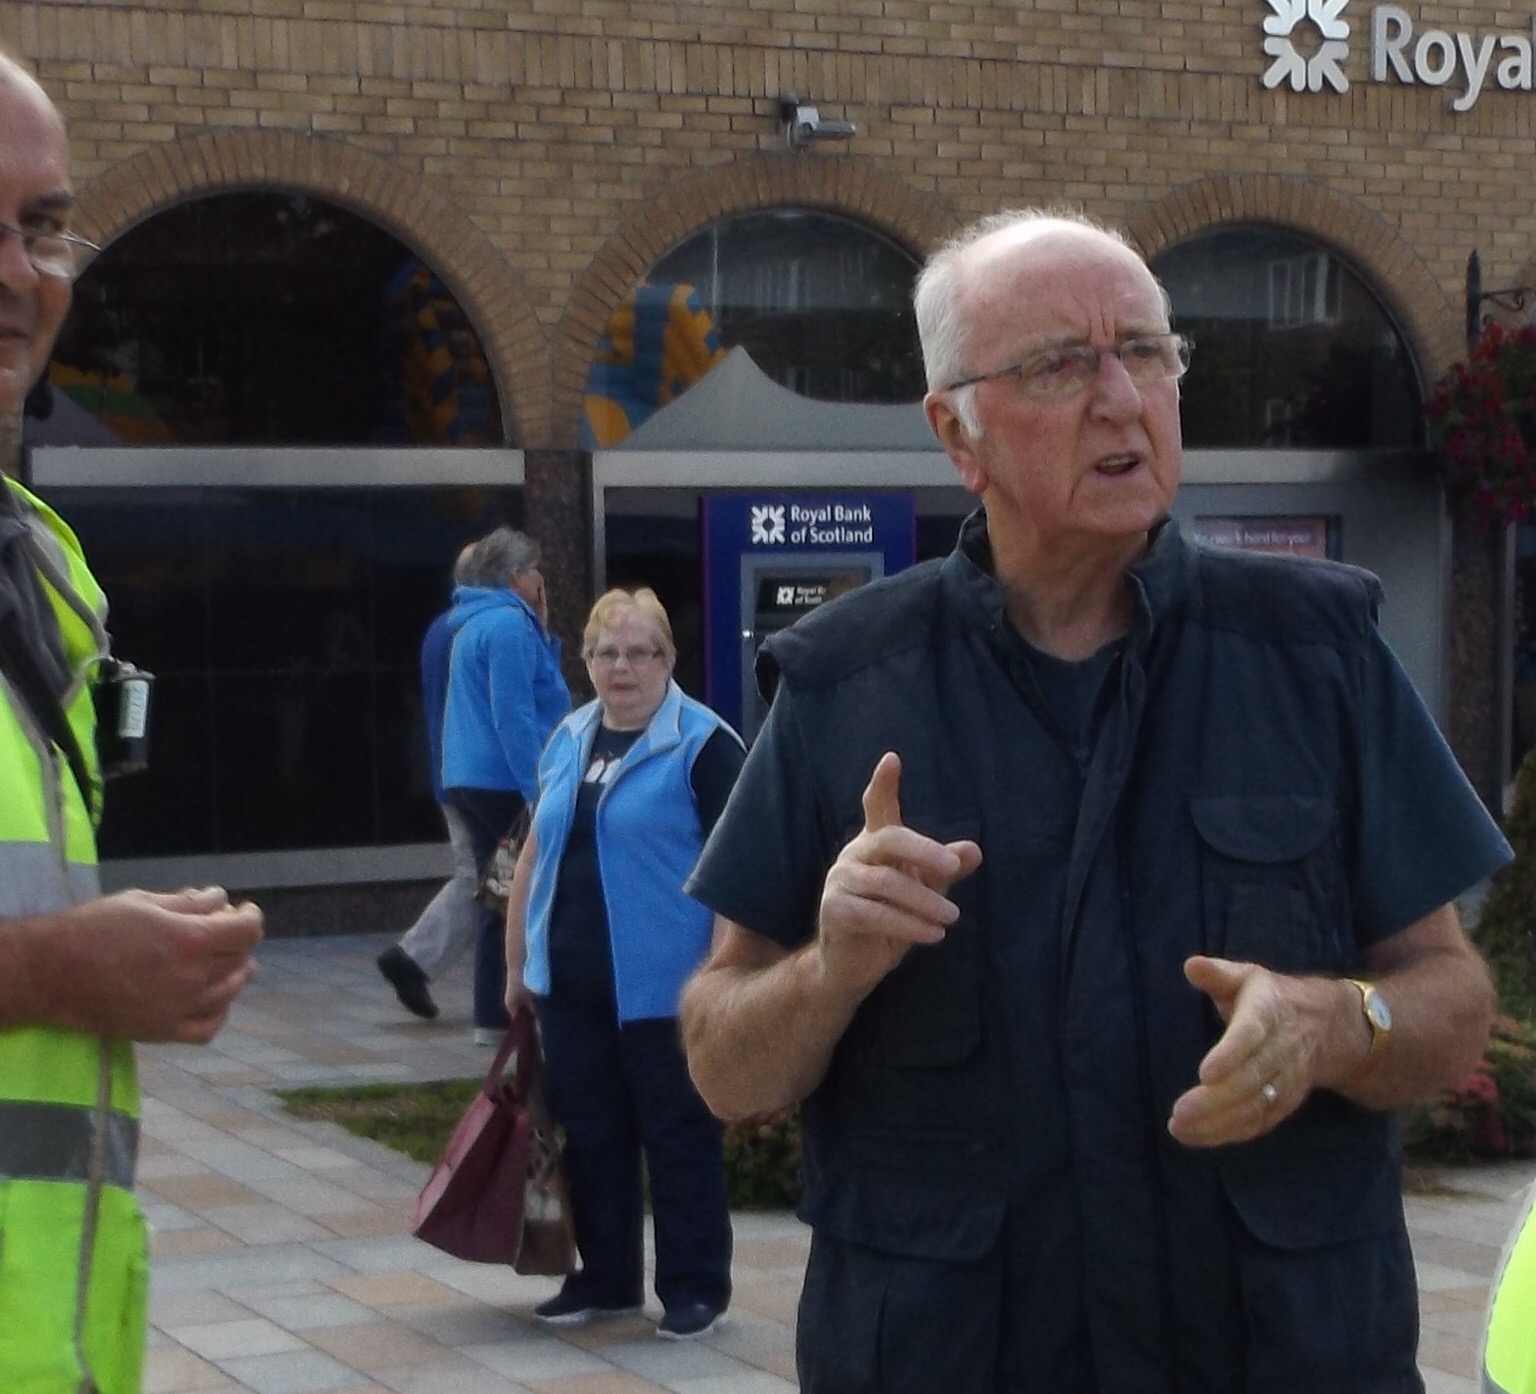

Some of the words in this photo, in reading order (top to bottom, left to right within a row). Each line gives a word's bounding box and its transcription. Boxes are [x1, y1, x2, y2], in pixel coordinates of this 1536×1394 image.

[790, 504, 831, 526] Royal
[834, 504, 872, 522] Bank
[790, 526, 807, 544] of
[809, 526, 873, 544] Scotland
